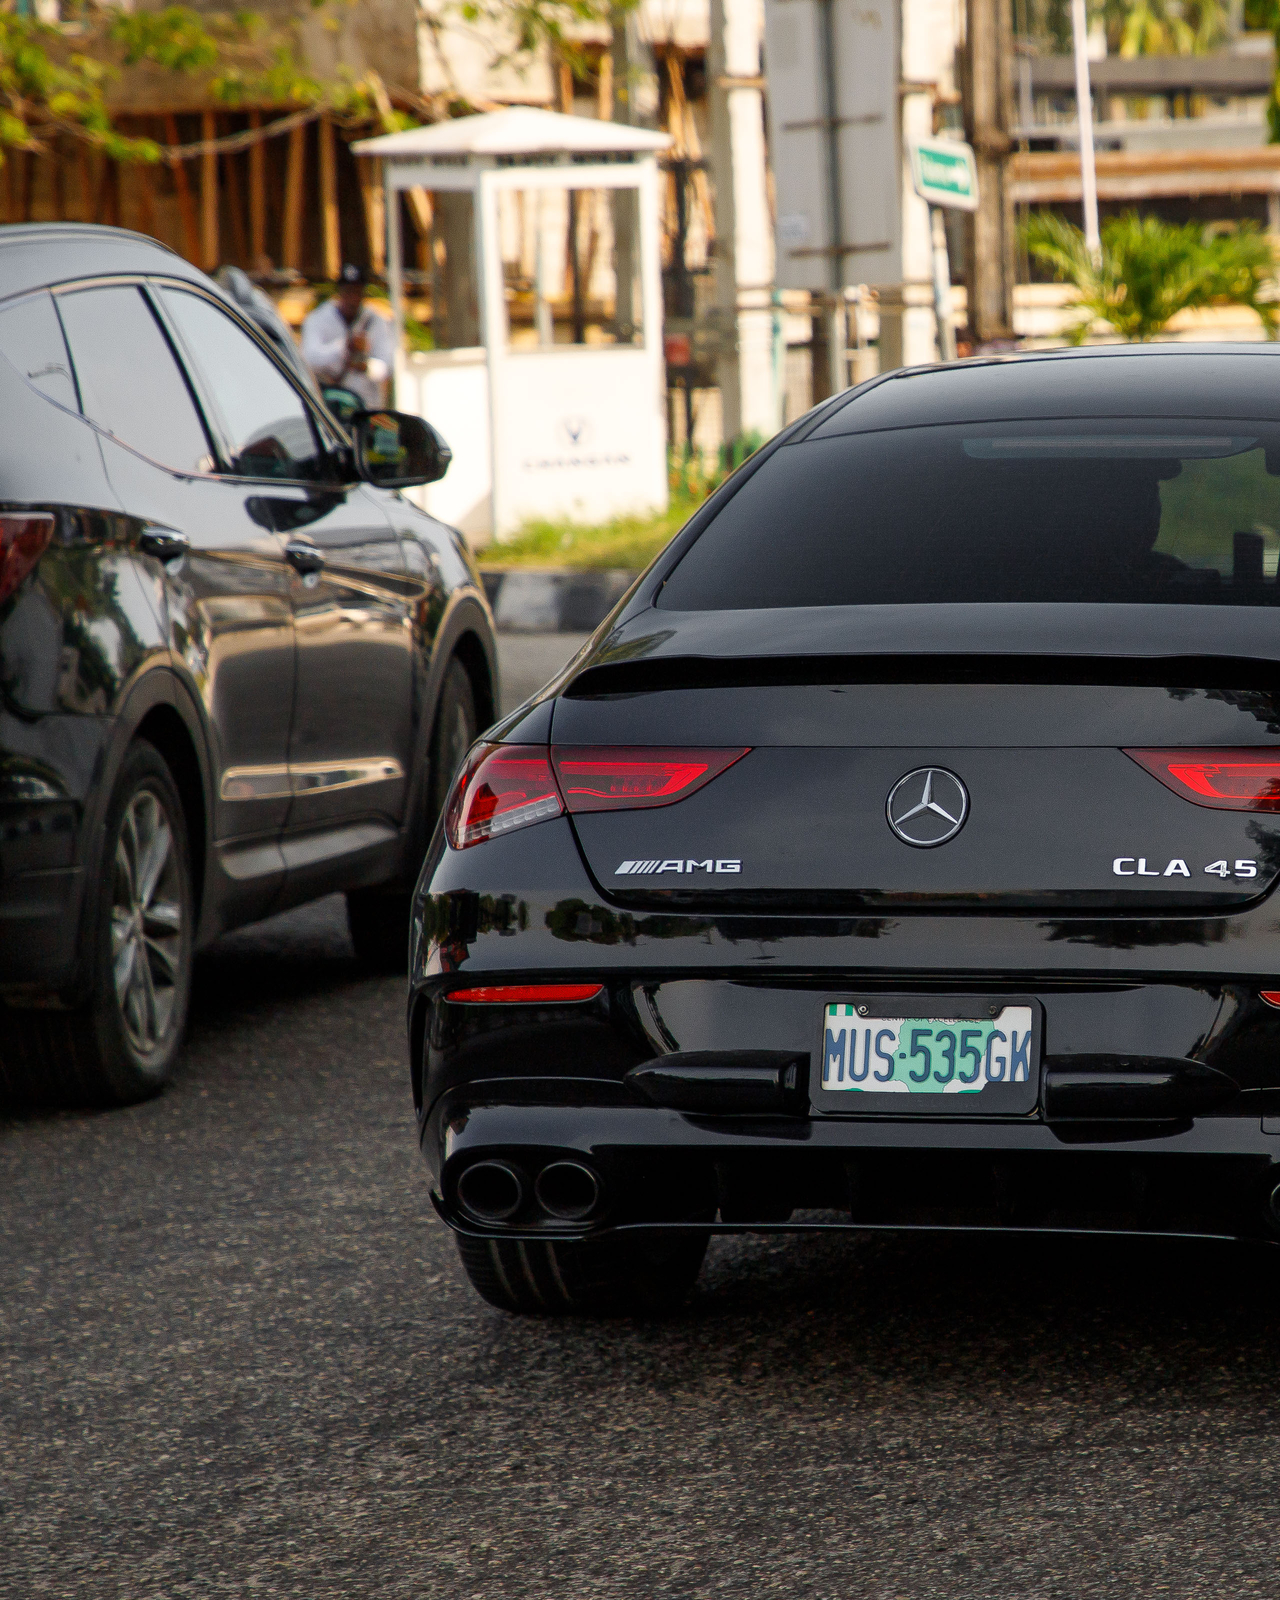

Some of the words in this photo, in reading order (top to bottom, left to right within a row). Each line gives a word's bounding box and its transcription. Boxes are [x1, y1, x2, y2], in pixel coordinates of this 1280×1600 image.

[655, 859, 742, 874] AMG
[1112, 857, 1191, 877] CLA
[1204, 859, 1258, 878] 45
[823, 1028, 1032, 1083] MUS-535GK
